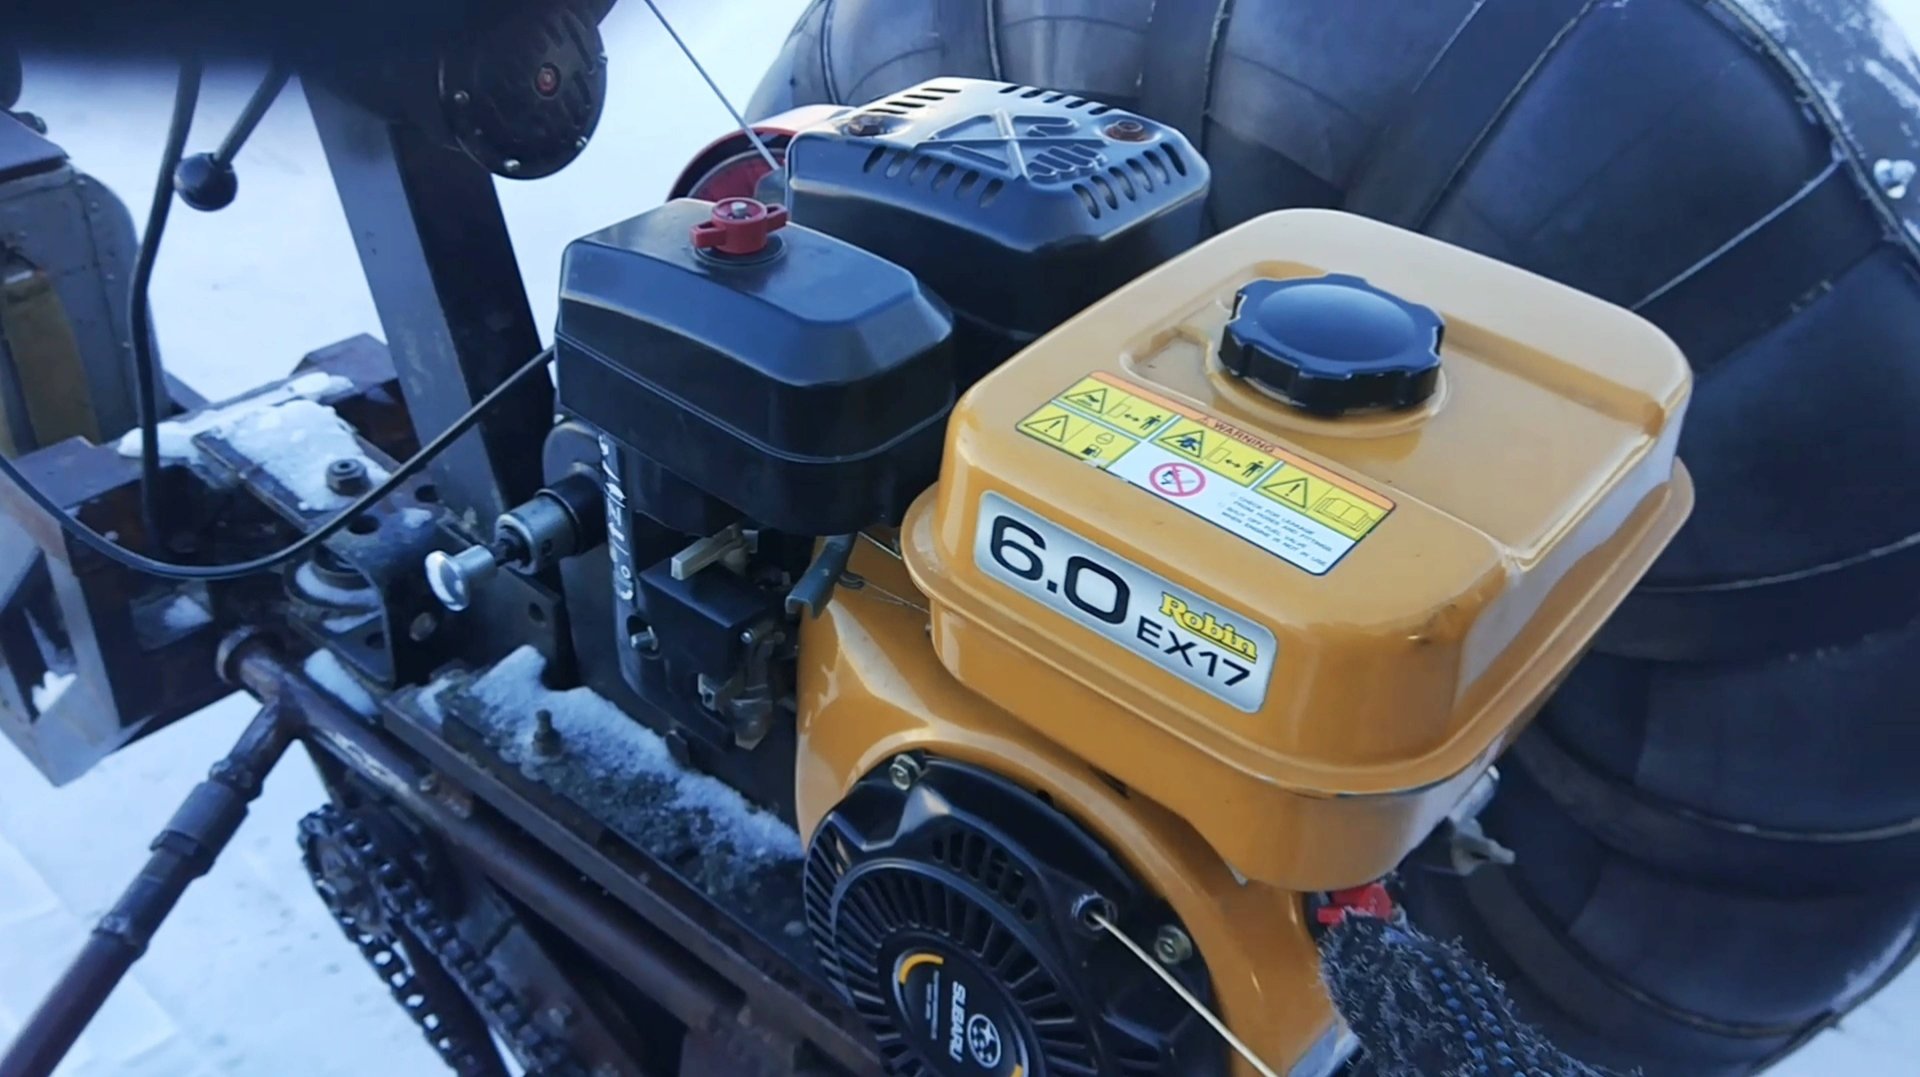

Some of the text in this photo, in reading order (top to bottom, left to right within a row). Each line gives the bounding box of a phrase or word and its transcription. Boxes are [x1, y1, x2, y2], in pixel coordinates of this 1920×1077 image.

[1212, 421, 1275, 455] WARNING
[1264, 508, 1281, 518] FOR
[989, 514, 1131, 625] 6.0
[1136, 615, 1251, 687] EX17
[1158, 590, 1258, 664] Robin
[949, 980, 967, 1064] SUBARU
